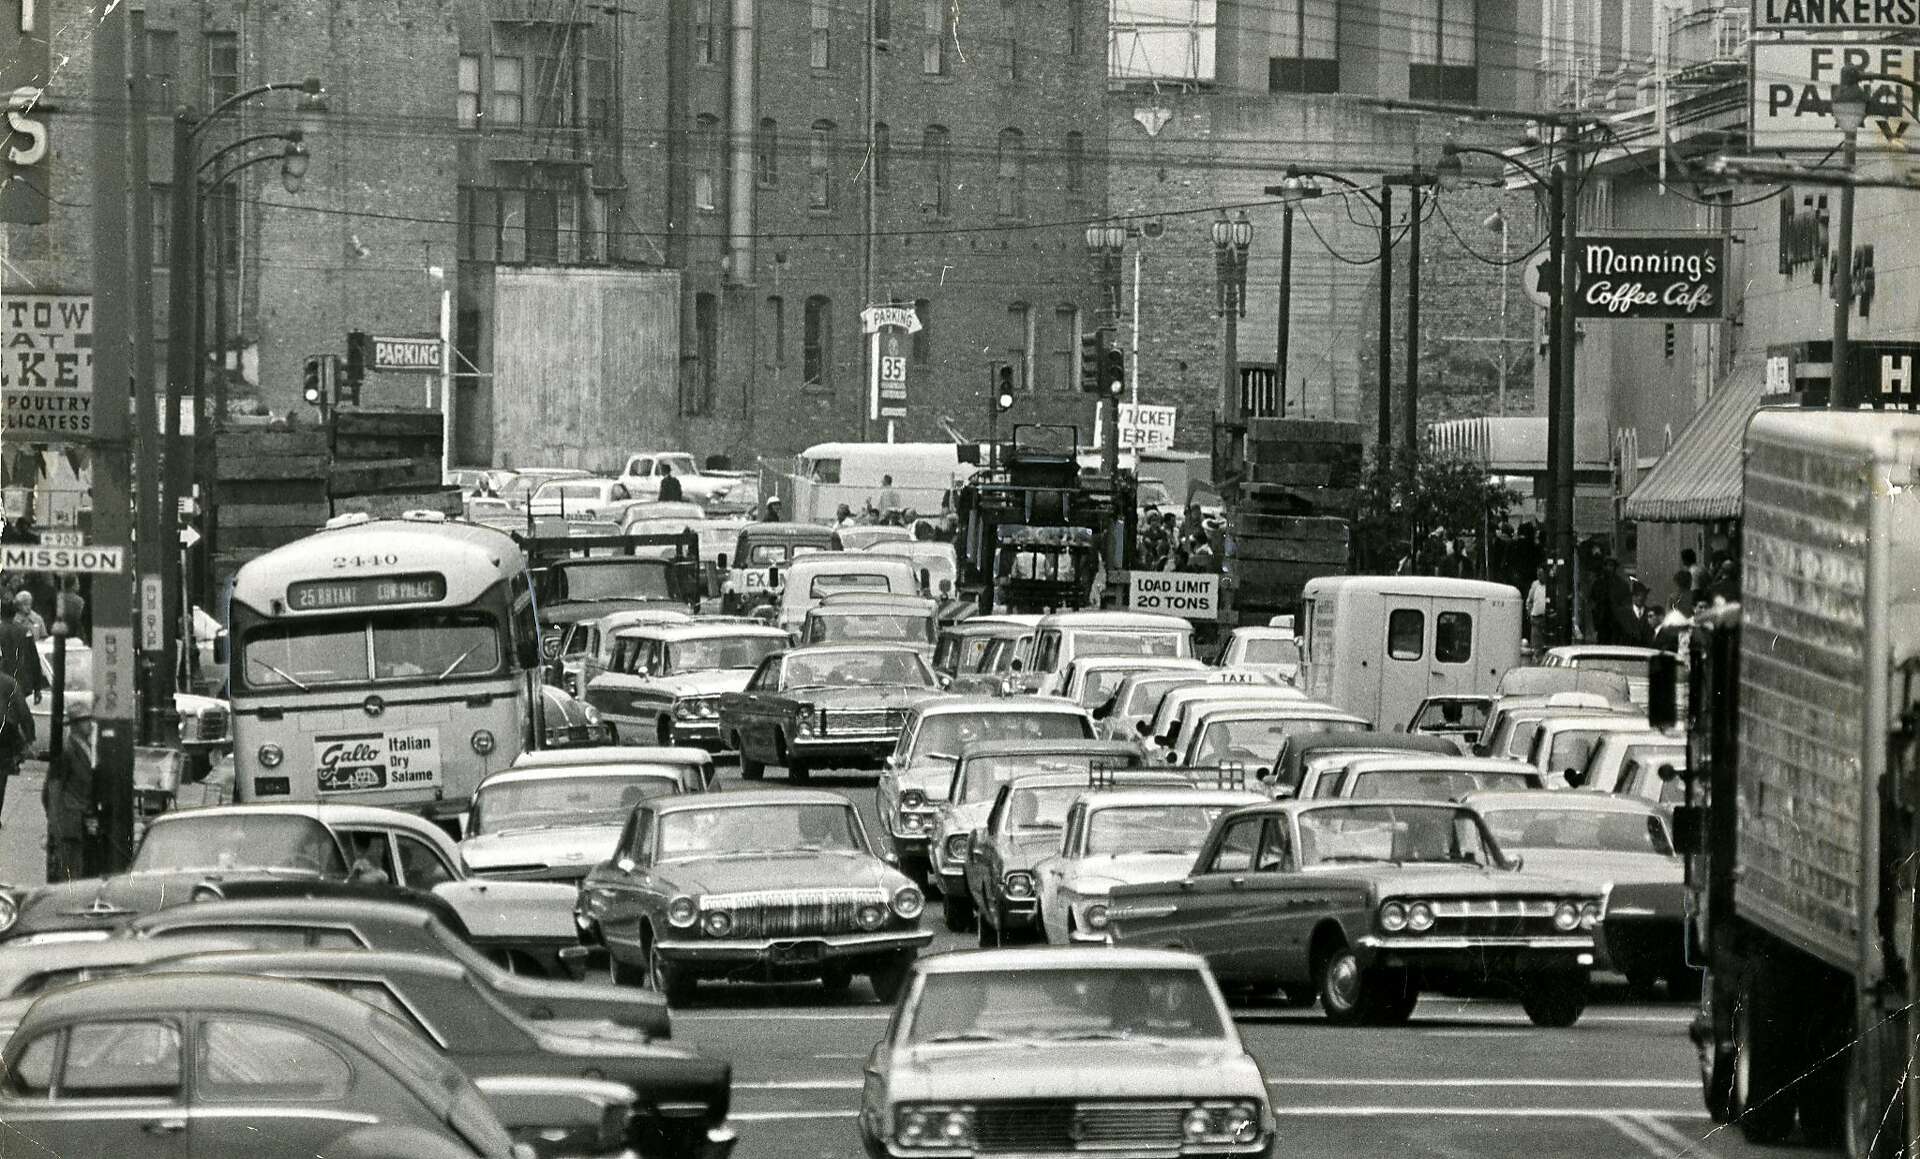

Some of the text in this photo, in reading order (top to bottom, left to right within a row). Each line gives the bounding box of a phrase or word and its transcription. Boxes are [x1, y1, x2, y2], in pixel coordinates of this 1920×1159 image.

[1766, 0, 1920, 24] LANKERS
[1586, 244, 1716, 281] Manning's
[1586, 281, 1713, 313] Coffee Cafe
[874, 308, 912, 328] PARKING
[375, 342, 439, 364] PARKING
[884, 358, 902, 379] 35
[7, 396, 90, 411] POULTRY
[6, 551, 117, 568] MISSION
[333, 554, 398, 569] 2440
[1137, 579, 1210, 593] LOAD LIMIT
[1137, 595, 1210, 610] 20 TONS
[1221, 674, 1253, 683] TAXI
[389, 736, 431, 752] Italian
[321, 743, 381, 781] Gallo
[390, 755, 409, 769] Dry
[391, 770, 433, 783] Salame
